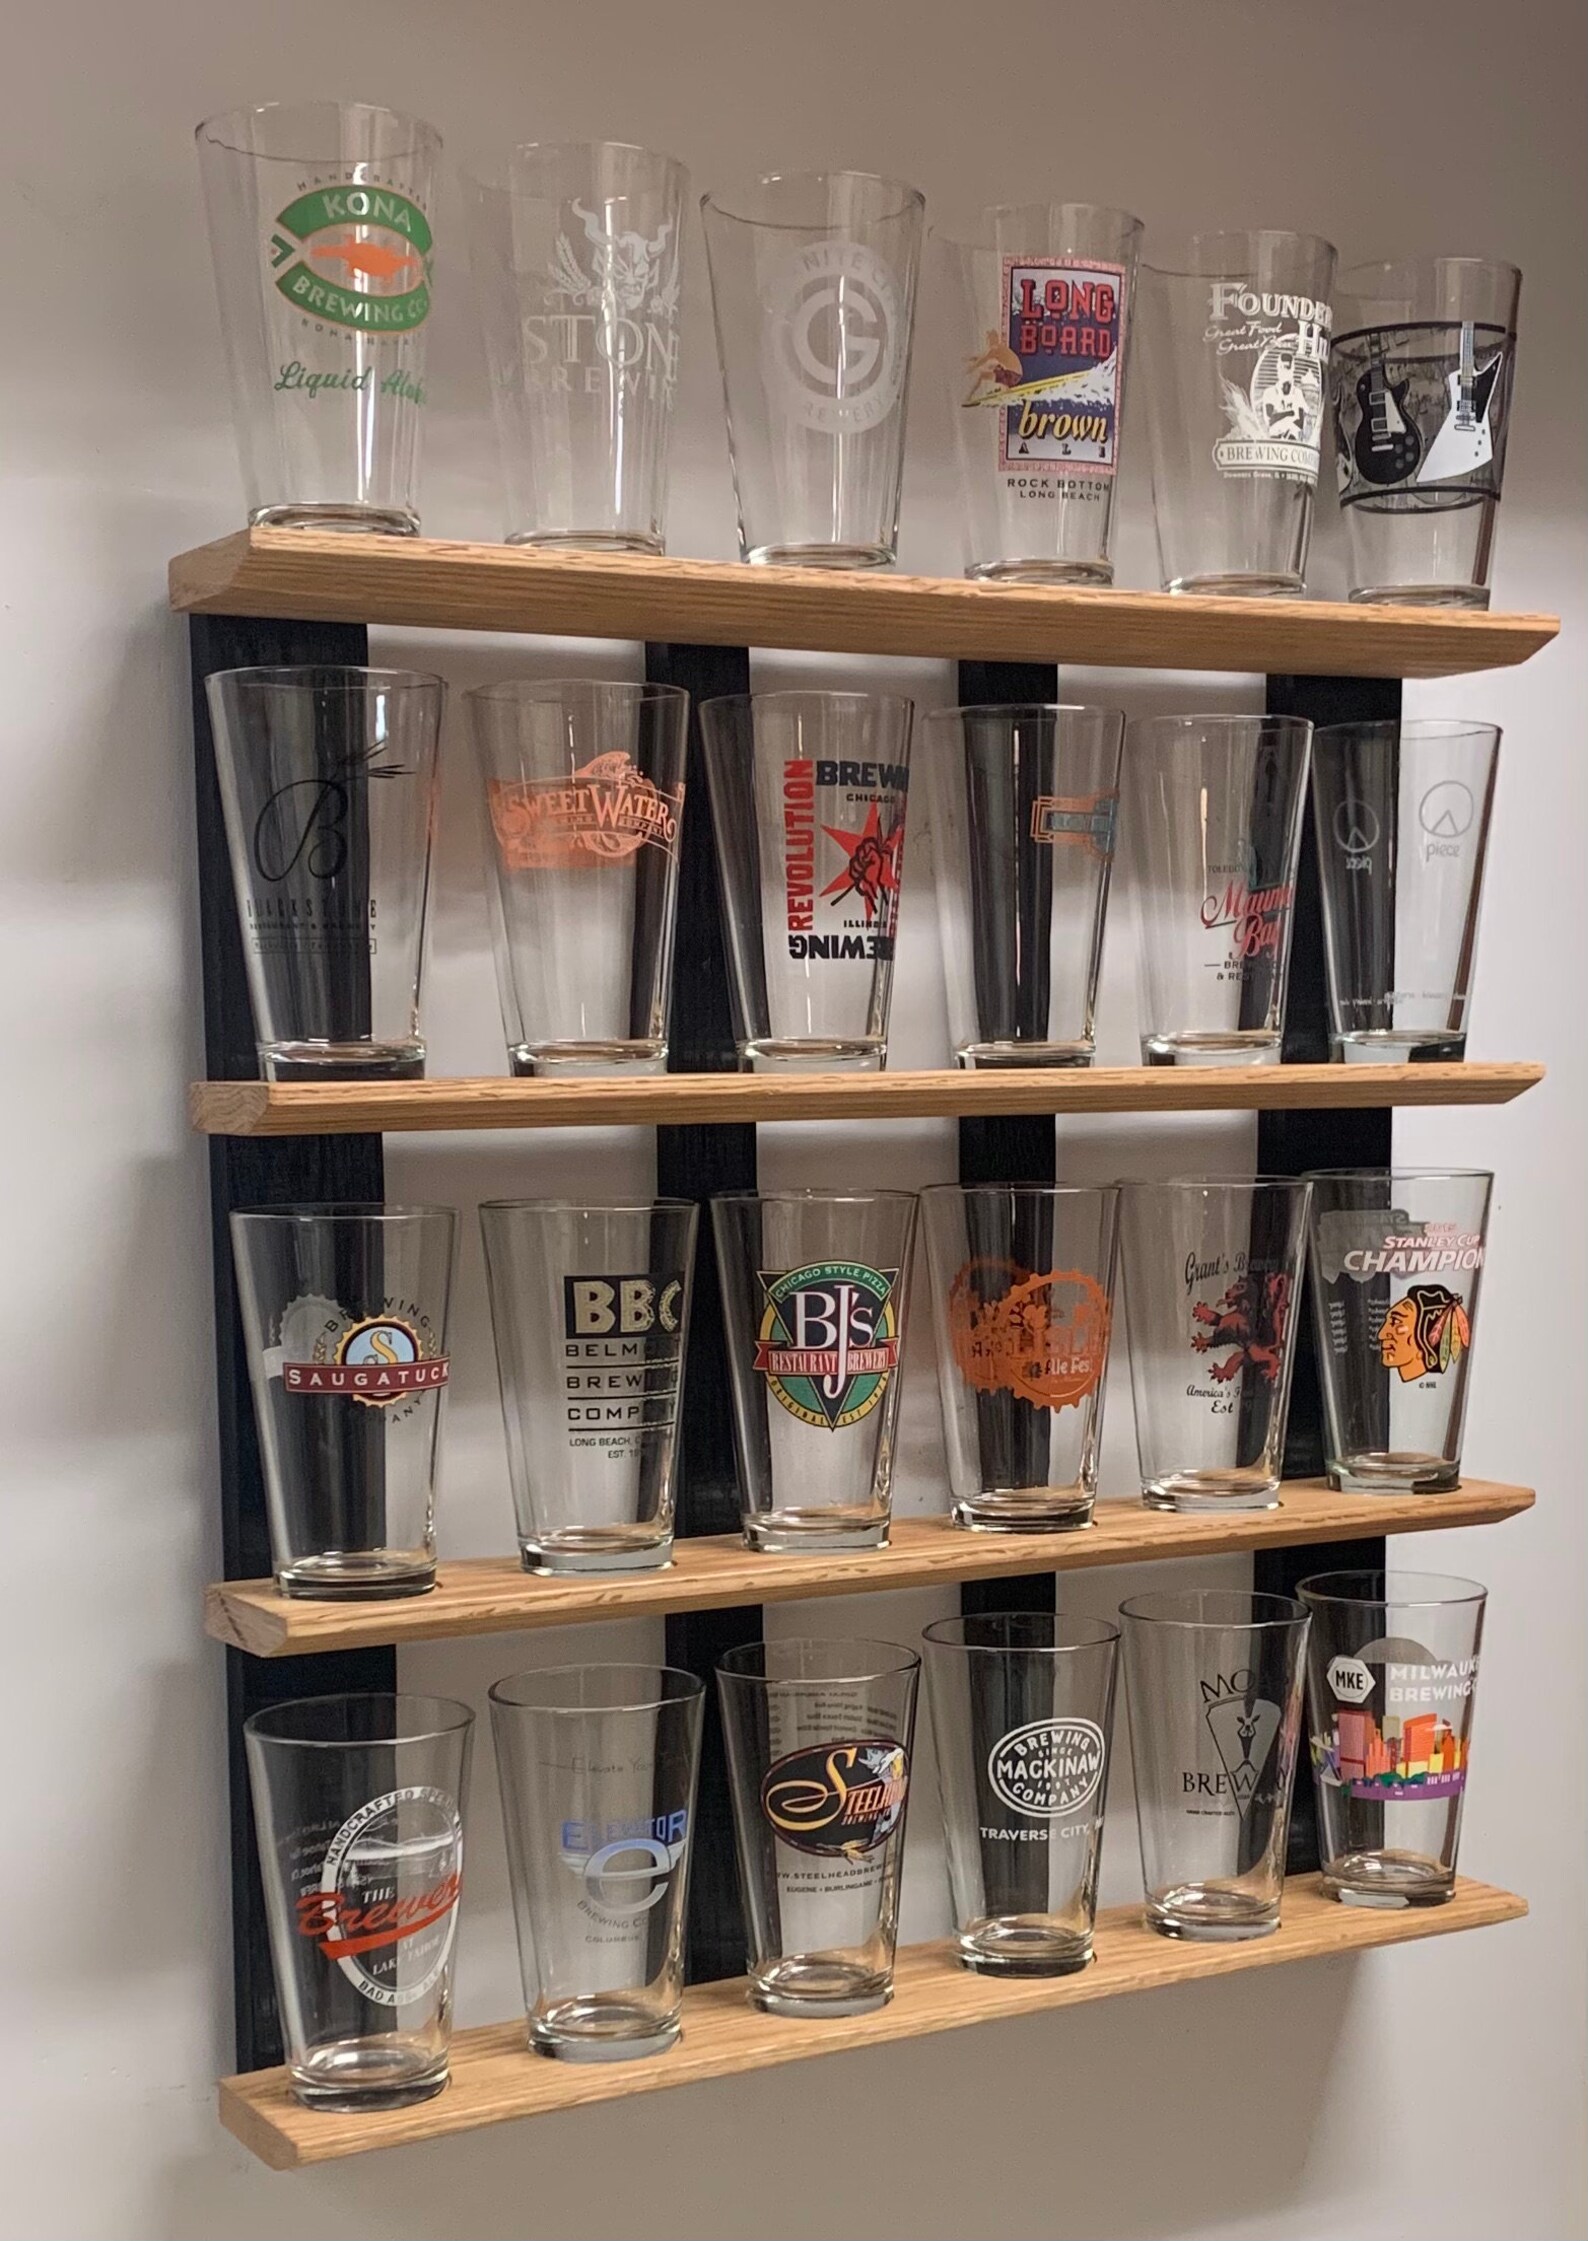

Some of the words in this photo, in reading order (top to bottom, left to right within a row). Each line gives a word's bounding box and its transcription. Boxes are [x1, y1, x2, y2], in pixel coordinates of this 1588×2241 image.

[322, 191, 412, 233] KONA
[292, 275, 404, 323] BREWING
[1020, 278, 1115, 324] LONG
[1019, 324, 1111, 361] BOARD
[274, 360, 373, 399] Liquid
[1017, 399, 1109, 444] brown
[1226, 446, 1288, 463] BREWING
[1007, 478, 1049, 488] ROCK
[1057, 479, 1110, 491] BOTTOM
[1020, 490, 1056, 499] LONG
[1062, 491, 1101, 501] BEACH
[783, 759, 815, 932] REVOLUTION
[1426, 841, 1462, 863] piece
[1383, 1235, 1454, 1249] STANLEY
[775, 1269, 822, 1299] CHICAGO
[824, 1265, 860, 1276] STYLE
[863, 1272, 886, 1295] PIZZA
[1185, 1252, 1230, 1296] Grant's
[288, 1361, 449, 1387] SAUGATUCK
[772, 1353, 837, 1372] RESTAURANT
[847, 1351, 887, 1371] BREWERY
[569, 1437, 596, 1447] LONG
[1336, 1670, 1363, 1690] MKE
[1390, 1681, 1471, 1701] BREWING
[1014, 1730, 1090, 1756] BREWING
[997, 1750, 1101, 1779] MACKINAW
[1012, 1776, 1088, 1806] COMPANY
[326, 1789, 415, 1866] HANDCRAFTED
[980, 1827, 1056, 1840] TRAVERSE
[362, 1886, 396, 1904] THE
